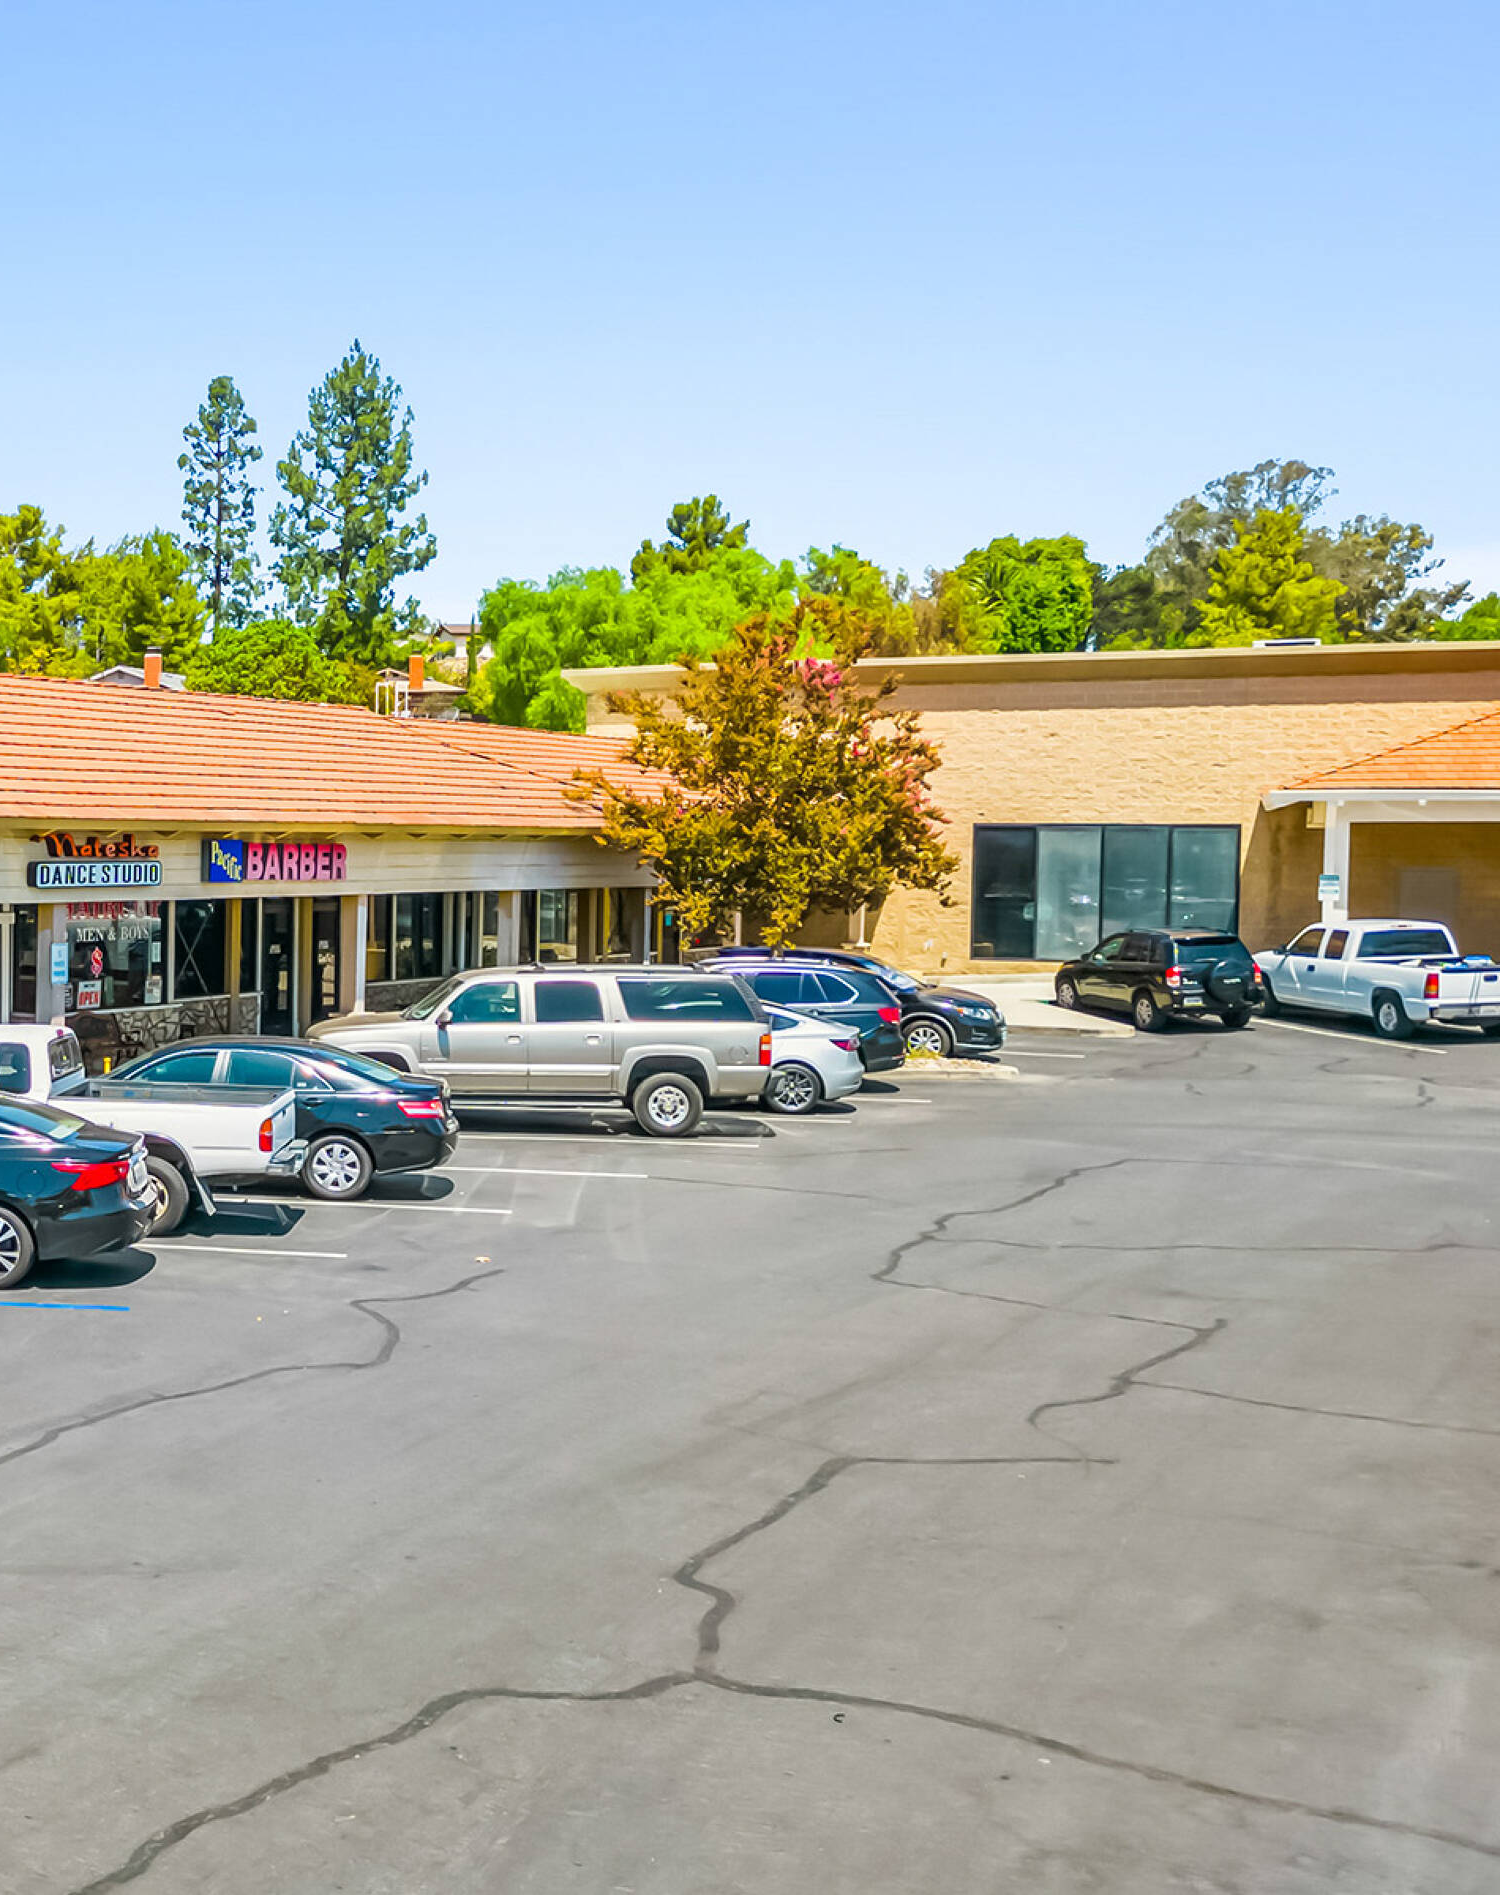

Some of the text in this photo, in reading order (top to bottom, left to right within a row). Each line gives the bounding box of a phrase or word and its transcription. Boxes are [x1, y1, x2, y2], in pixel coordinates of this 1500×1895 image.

[246, 842, 347, 880] BARBER
[40, 864, 159, 885] DANCE STUDIO
[77, 925, 149, 941] MEN & BOYS
[79, 992, 100, 1006] OPEN
